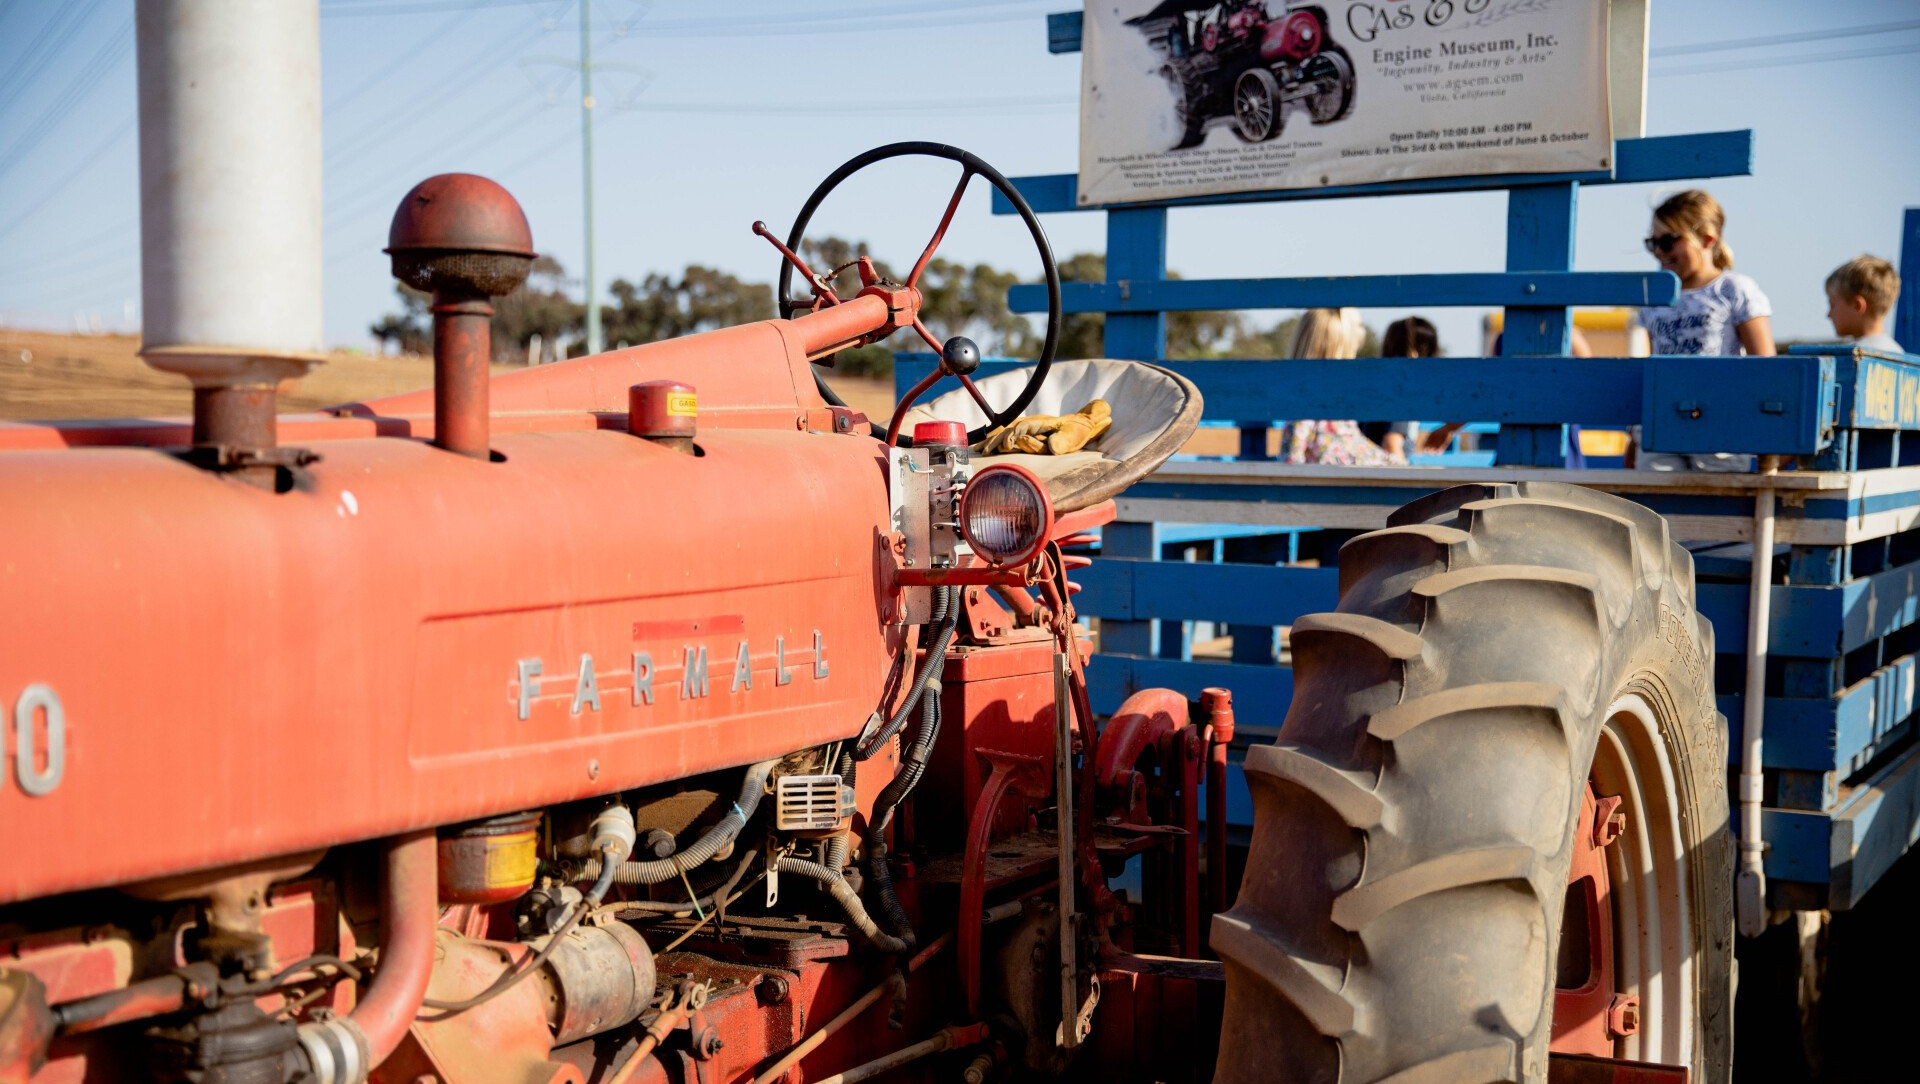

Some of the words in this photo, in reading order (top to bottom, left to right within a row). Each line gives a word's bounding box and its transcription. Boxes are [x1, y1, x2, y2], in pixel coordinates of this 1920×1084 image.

[1373, 48, 1432, 65] Engine
[1440, 38, 1521, 56] Museum,
[1527, 32, 1558, 48] Inc.
[1448, 55, 1500, 71] Industry
[1505, 55, 1515, 65] &
[1375, 146, 1390, 155] Are
[1392, 144, 1408, 154] The
[1412, 143, 1427, 153] 3rd
[1456, 138, 1500, 149] Weekend
[1502, 137, 1513, 146] of
[1515, 136, 1538, 146] June
[1540, 133, 1548, 143] &
[1549, 132, 1589, 142] October
[1390, 132, 1414, 141] Open
[1416, 130, 1439, 140] Daily
[1443, 127, 1468, 137] 10:00
[1470, 125, 1485, 134] AM
[1516, 121, 1532, 131] PM
[517, 629, 829, 721] FARMALL
[0, 681, 65, 797] 0
